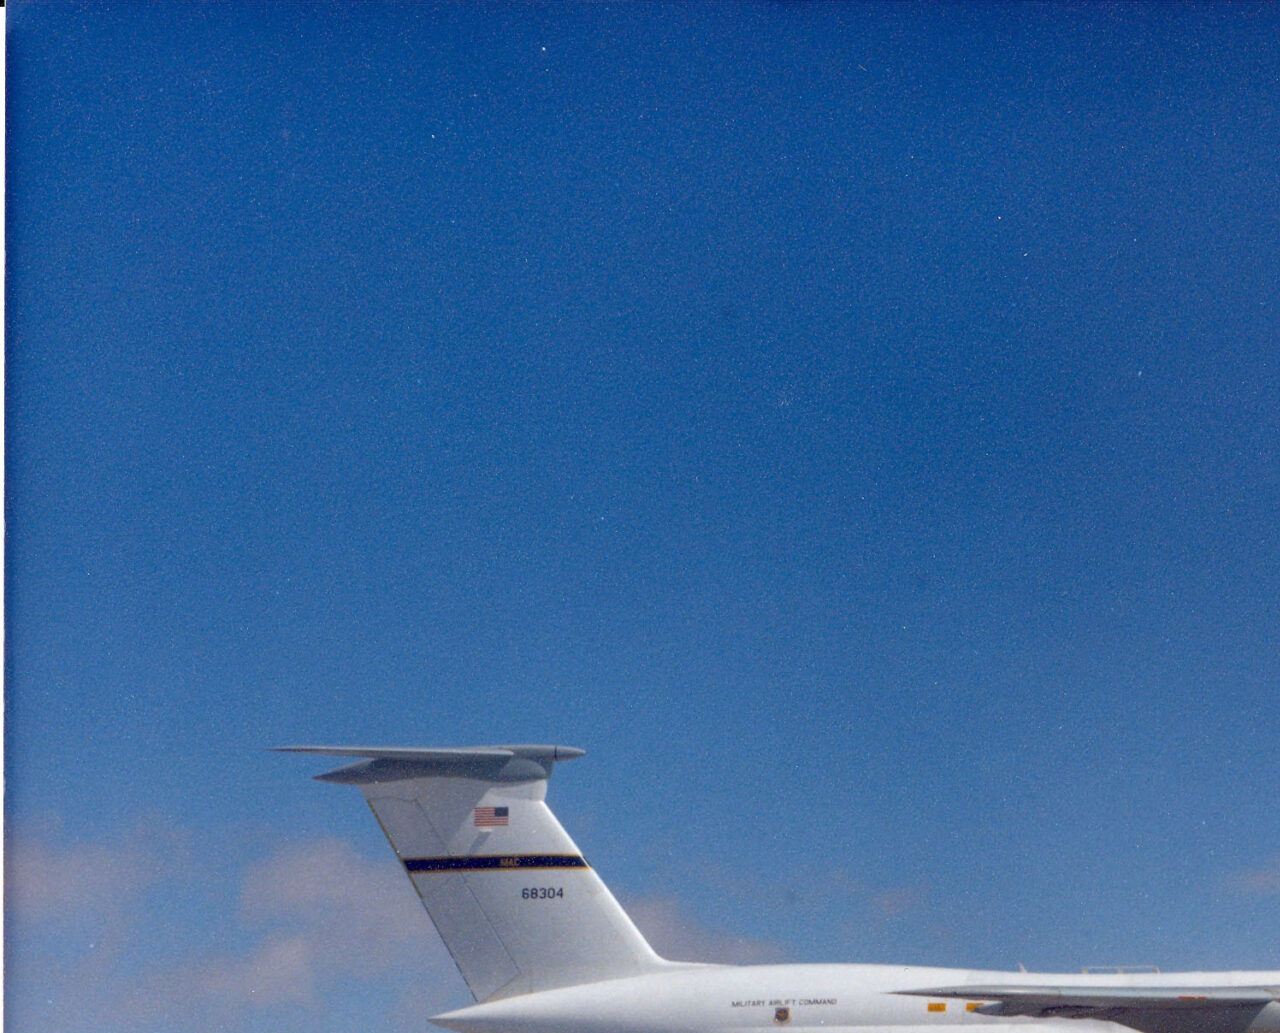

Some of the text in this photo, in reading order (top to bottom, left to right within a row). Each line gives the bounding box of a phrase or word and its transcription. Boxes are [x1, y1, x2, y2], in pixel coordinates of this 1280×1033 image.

[521, 887, 564, 899] 68304
[731, 998, 838, 1008] MILITARY AIRLIFT COMMAND
